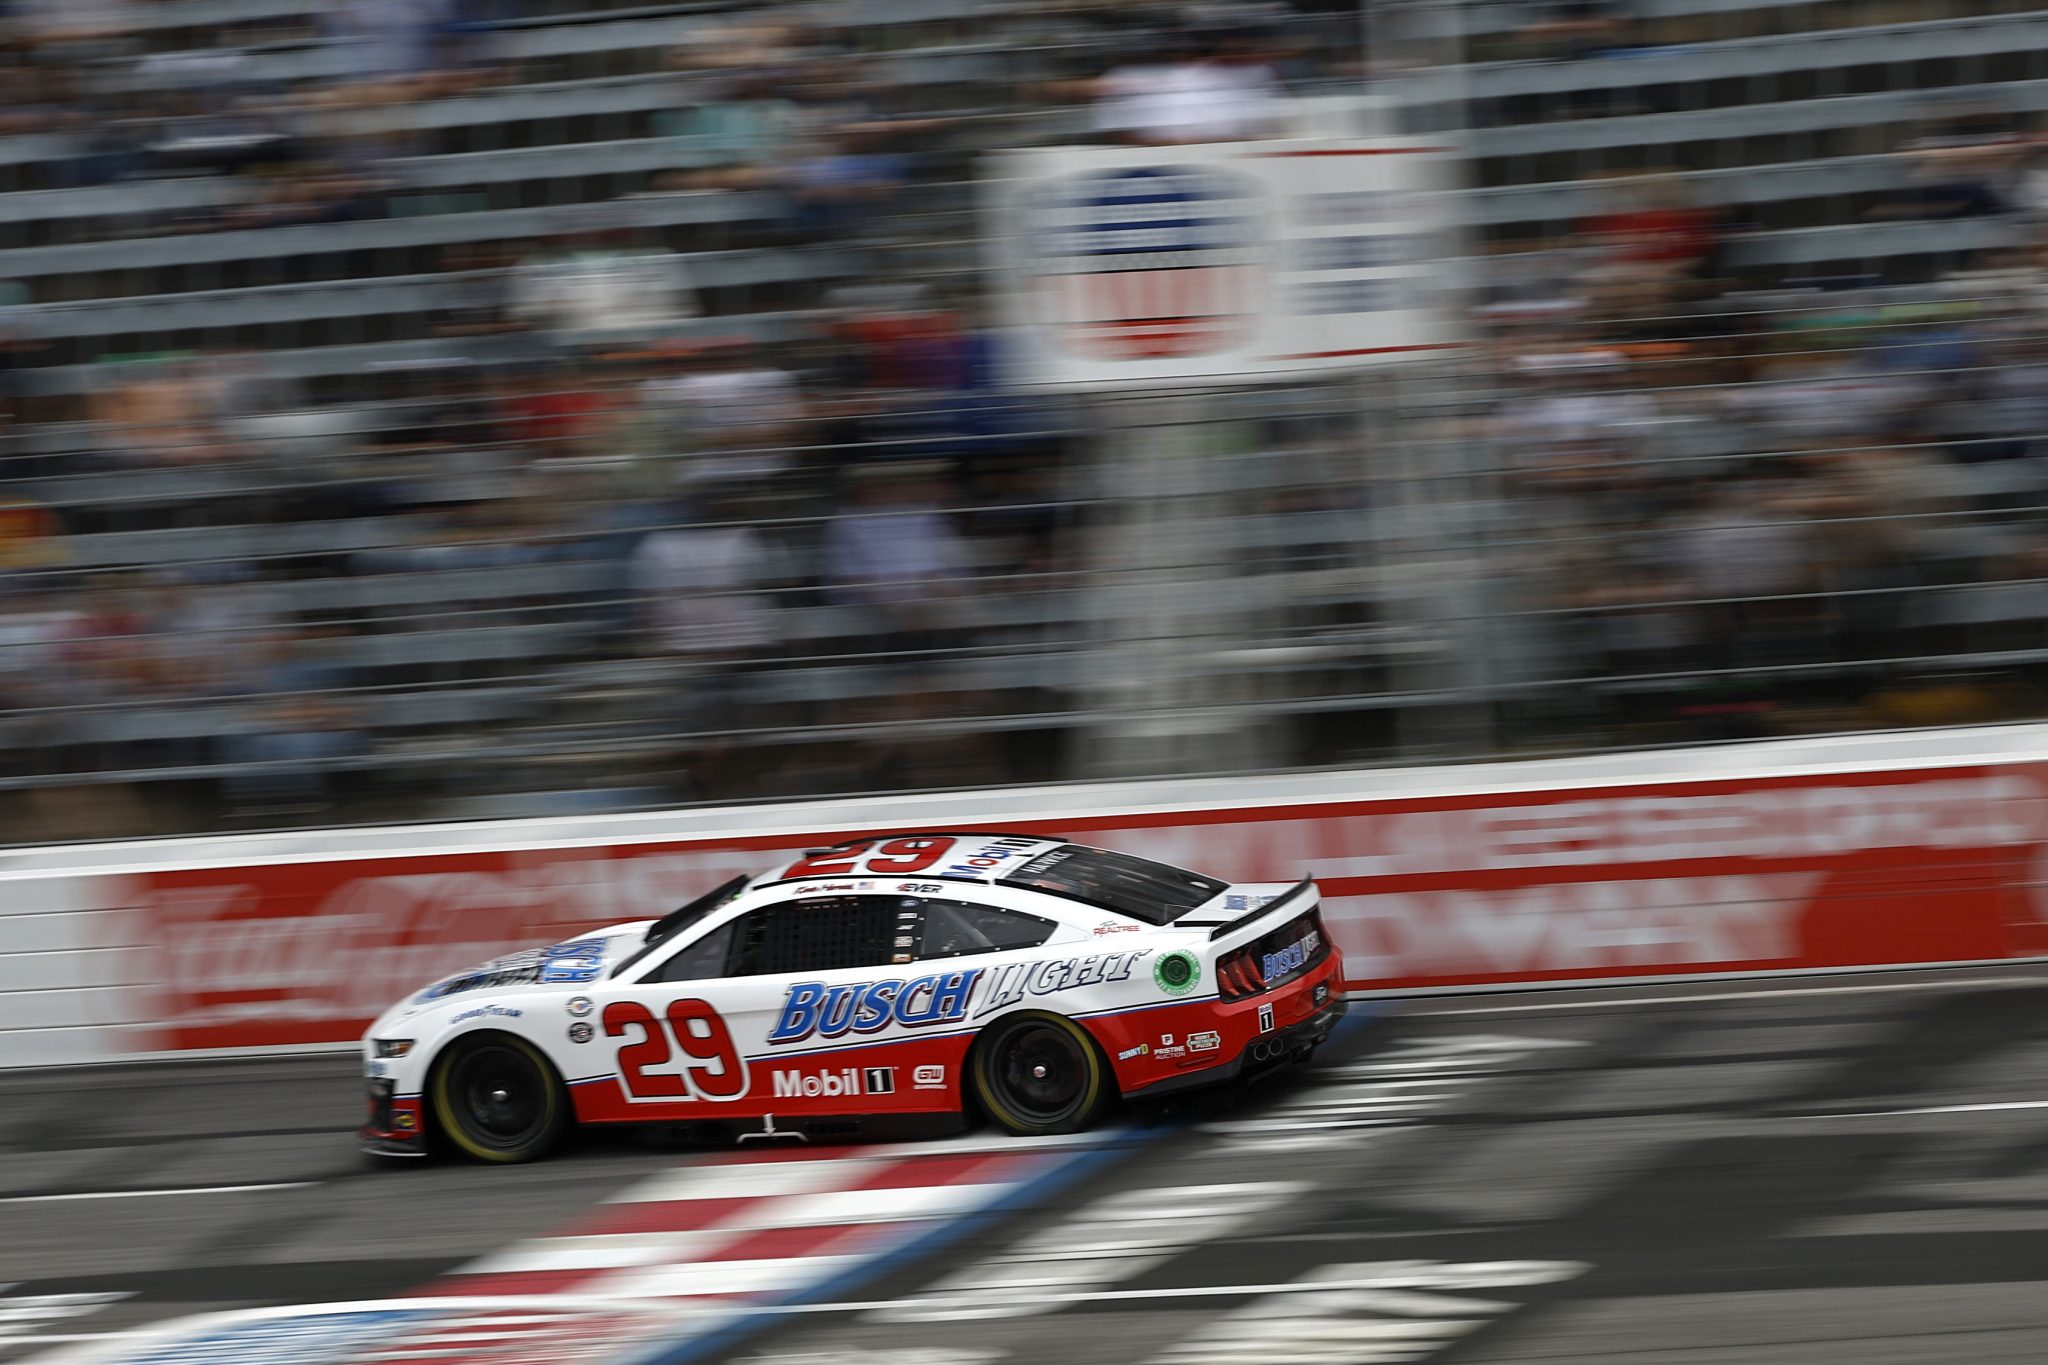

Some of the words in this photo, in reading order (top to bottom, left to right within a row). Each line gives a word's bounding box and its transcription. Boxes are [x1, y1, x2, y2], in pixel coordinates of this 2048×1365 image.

[781, 836, 958, 879] 29
[1093, 925, 1140, 936] REALTREE
[1262, 941, 1304, 983] BUSCH
[767, 967, 983, 1045] BUSCH
[973, 949, 1153, 1020] LIGHT
[603, 998, 747, 1101] 29
[1154, 1045, 1186, 1056] PRISTINE
[772, 1068, 860, 1097] Mobil
[868, 1069, 888, 1093] 1
